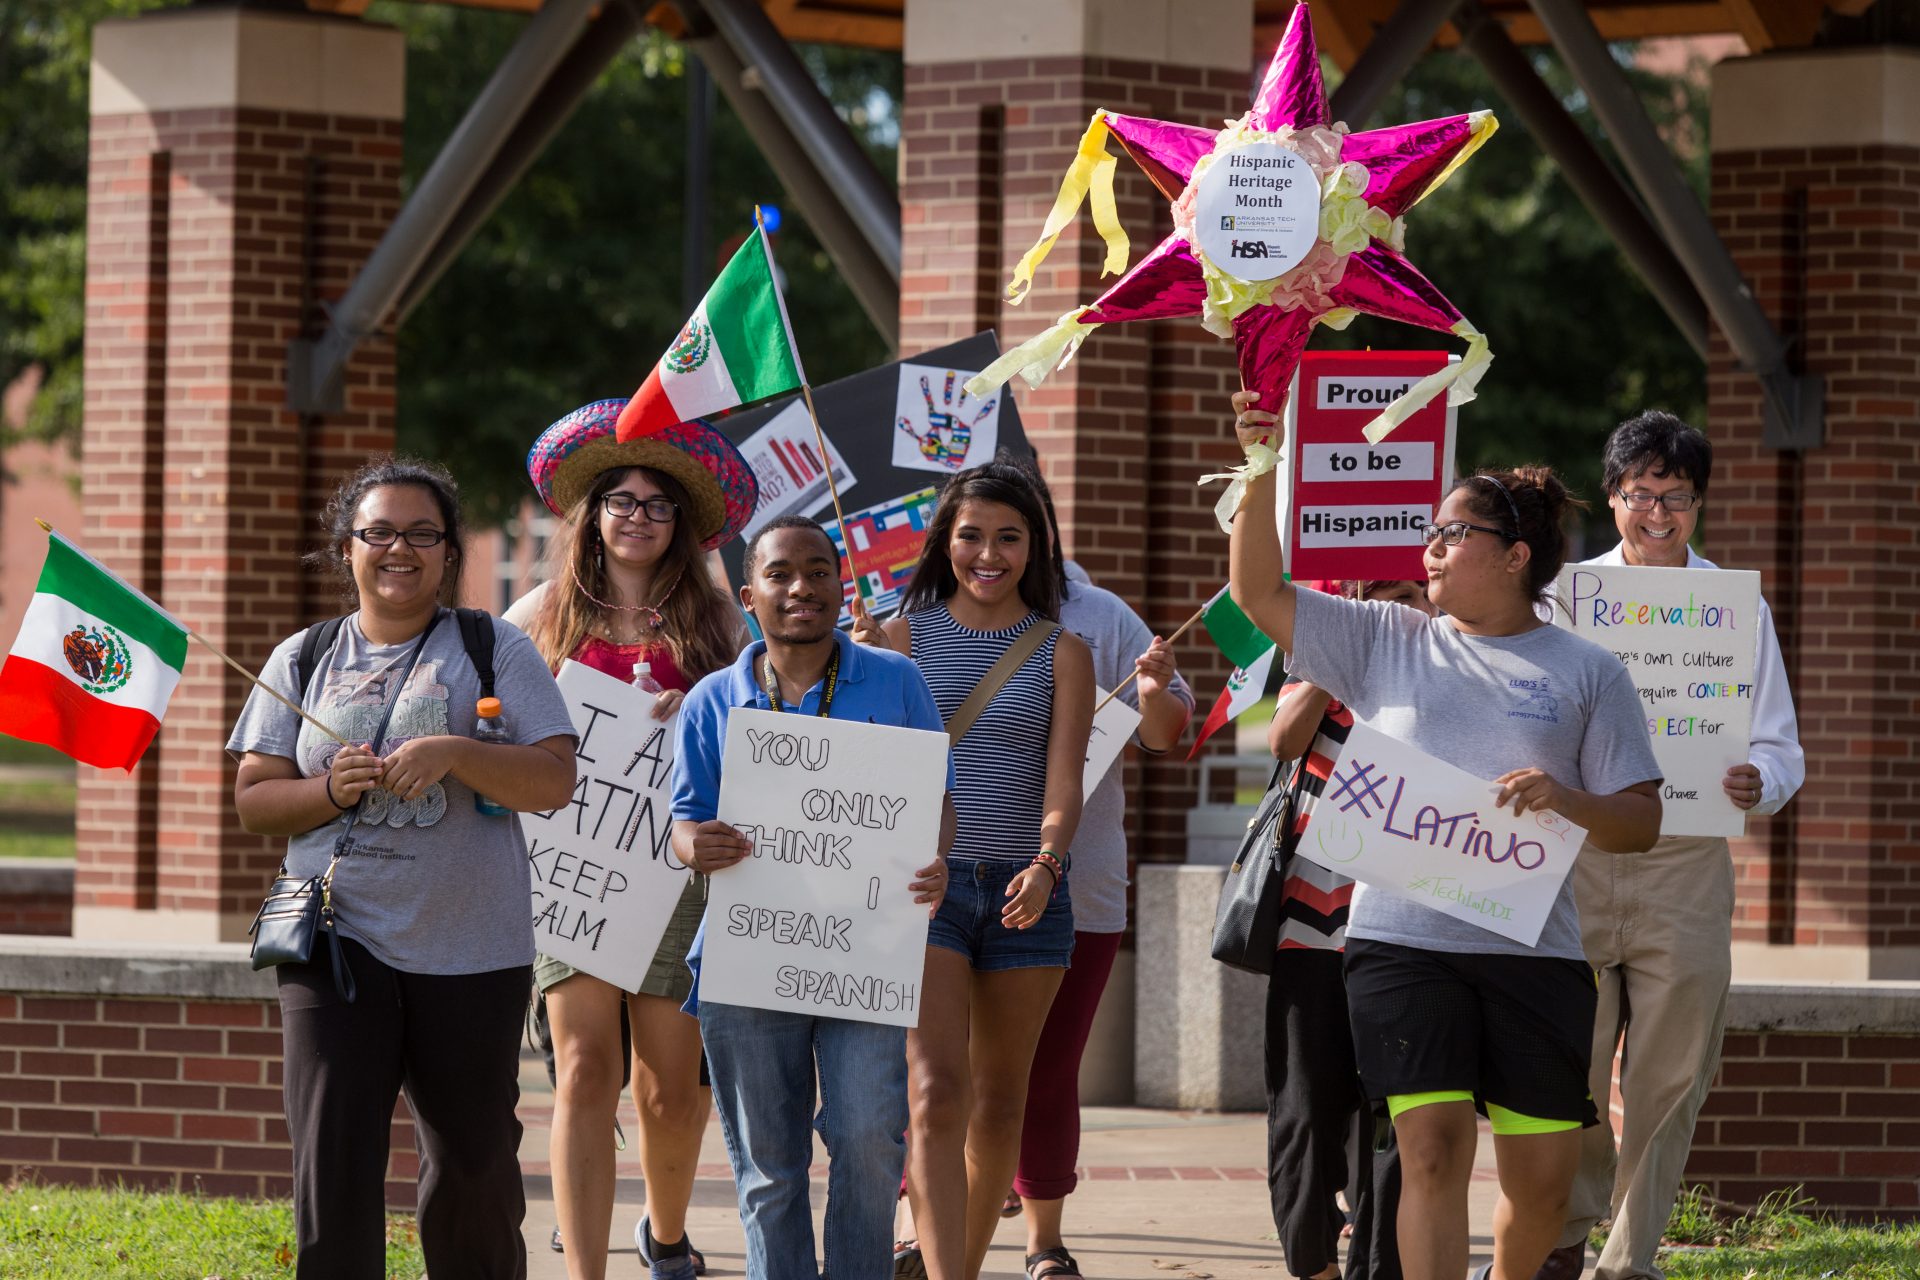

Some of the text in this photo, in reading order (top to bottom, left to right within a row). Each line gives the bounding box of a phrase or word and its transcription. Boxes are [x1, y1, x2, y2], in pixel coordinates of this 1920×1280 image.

[1230, 155, 1295, 171] Hispanic
[1228, 174, 1293, 191] Heritage
[1235, 194, 1283, 208] Month
[1231, 240, 1269, 258] HSA
[1327, 383, 1409, 403] Proud
[1329, 450, 1402, 471] to be
[1302, 510, 1426, 537] Hispanic
[1644, 651, 1674, 666] own
[1509, 679, 1537, 689] LUD'S
[1637, 682, 1753, 704] require CONTEMPT
[575, 702, 618, 764] I
[1698, 718, 1725, 735] for
[746, 728, 830, 772] YOU
[1664, 785, 1699, 801] Chavez
[801, 788, 907, 831] ONLY
[351, 848, 416, 861] Blood Institute
[354, 843, 394, 853] Arkansas
[732, 823, 852, 870] THINK
[529, 838, 628, 903] KEEP
[867, 876, 881, 910] I
[727, 903, 852, 952] SPEAK
[775, 964, 916, 1012] SPANISH
